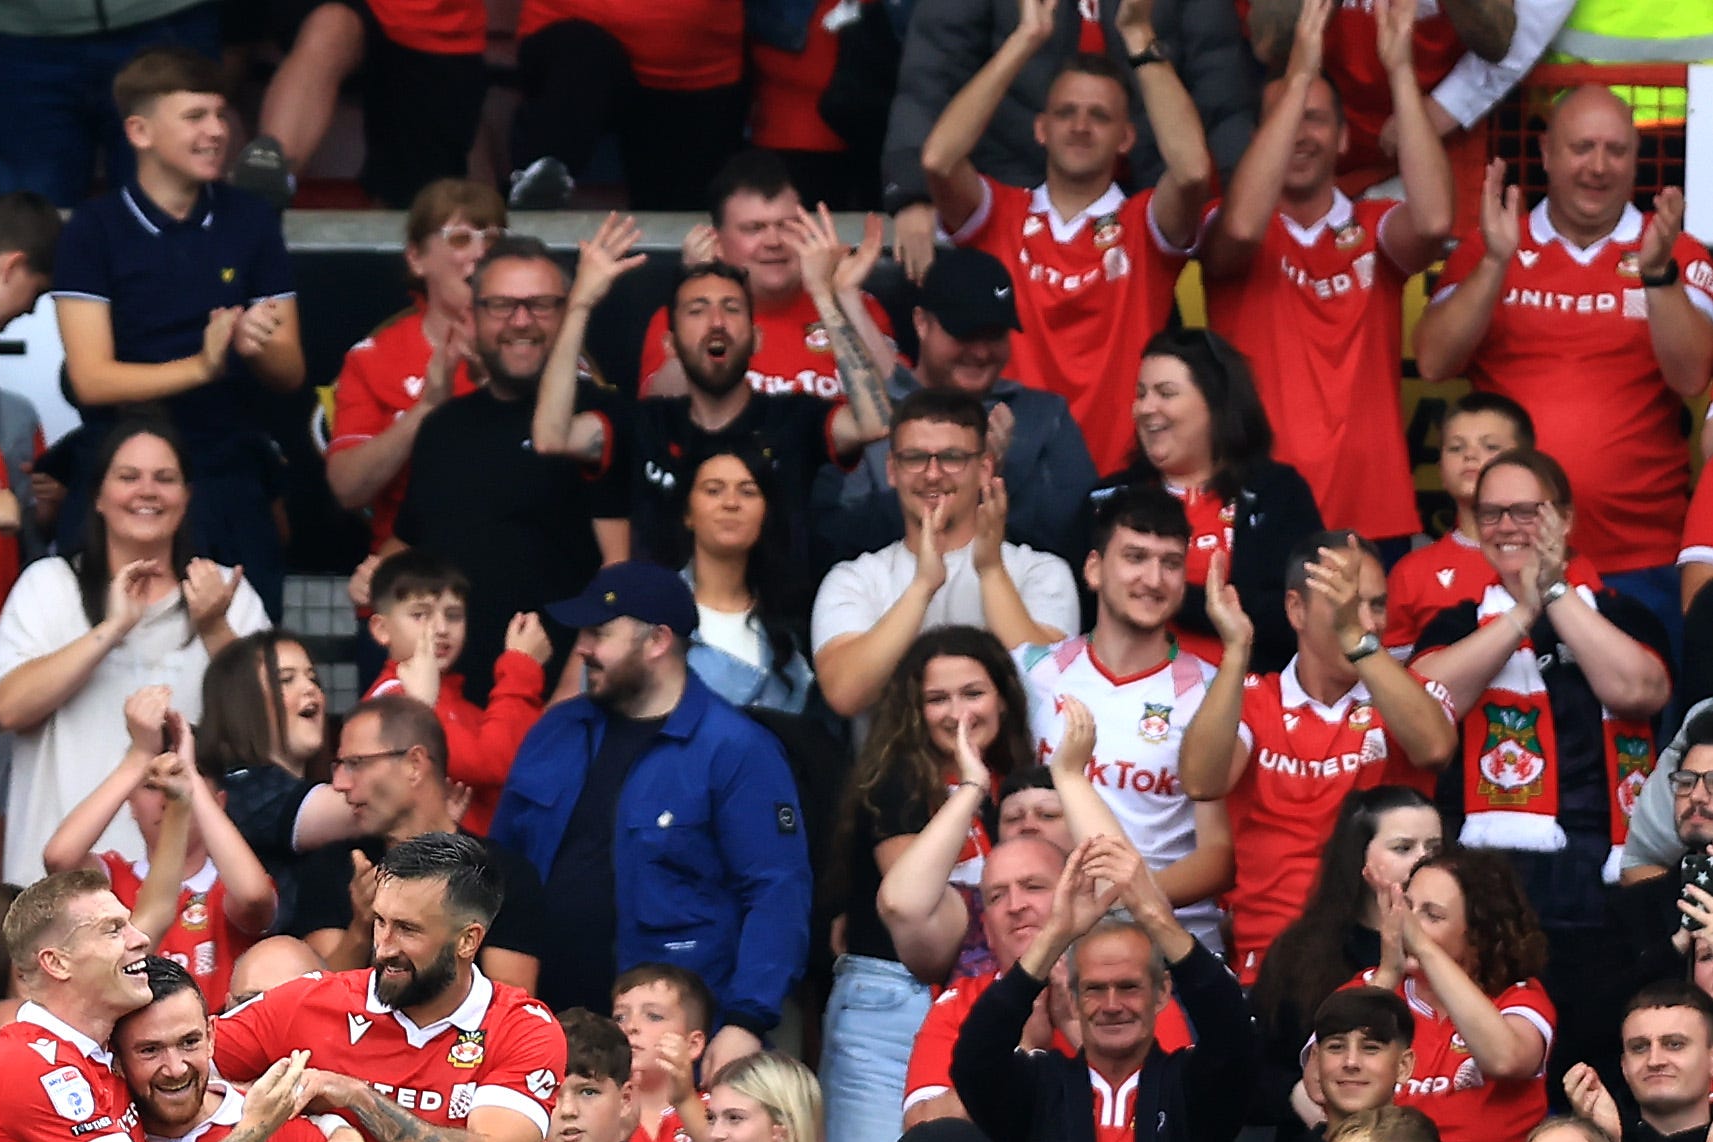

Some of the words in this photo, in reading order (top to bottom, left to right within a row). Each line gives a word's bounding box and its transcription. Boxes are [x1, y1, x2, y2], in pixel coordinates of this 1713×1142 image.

[1258, 748, 1358, 778] UNITED
[374, 1082, 442, 1110] TED
[1394, 1076, 1449, 1096] TED
